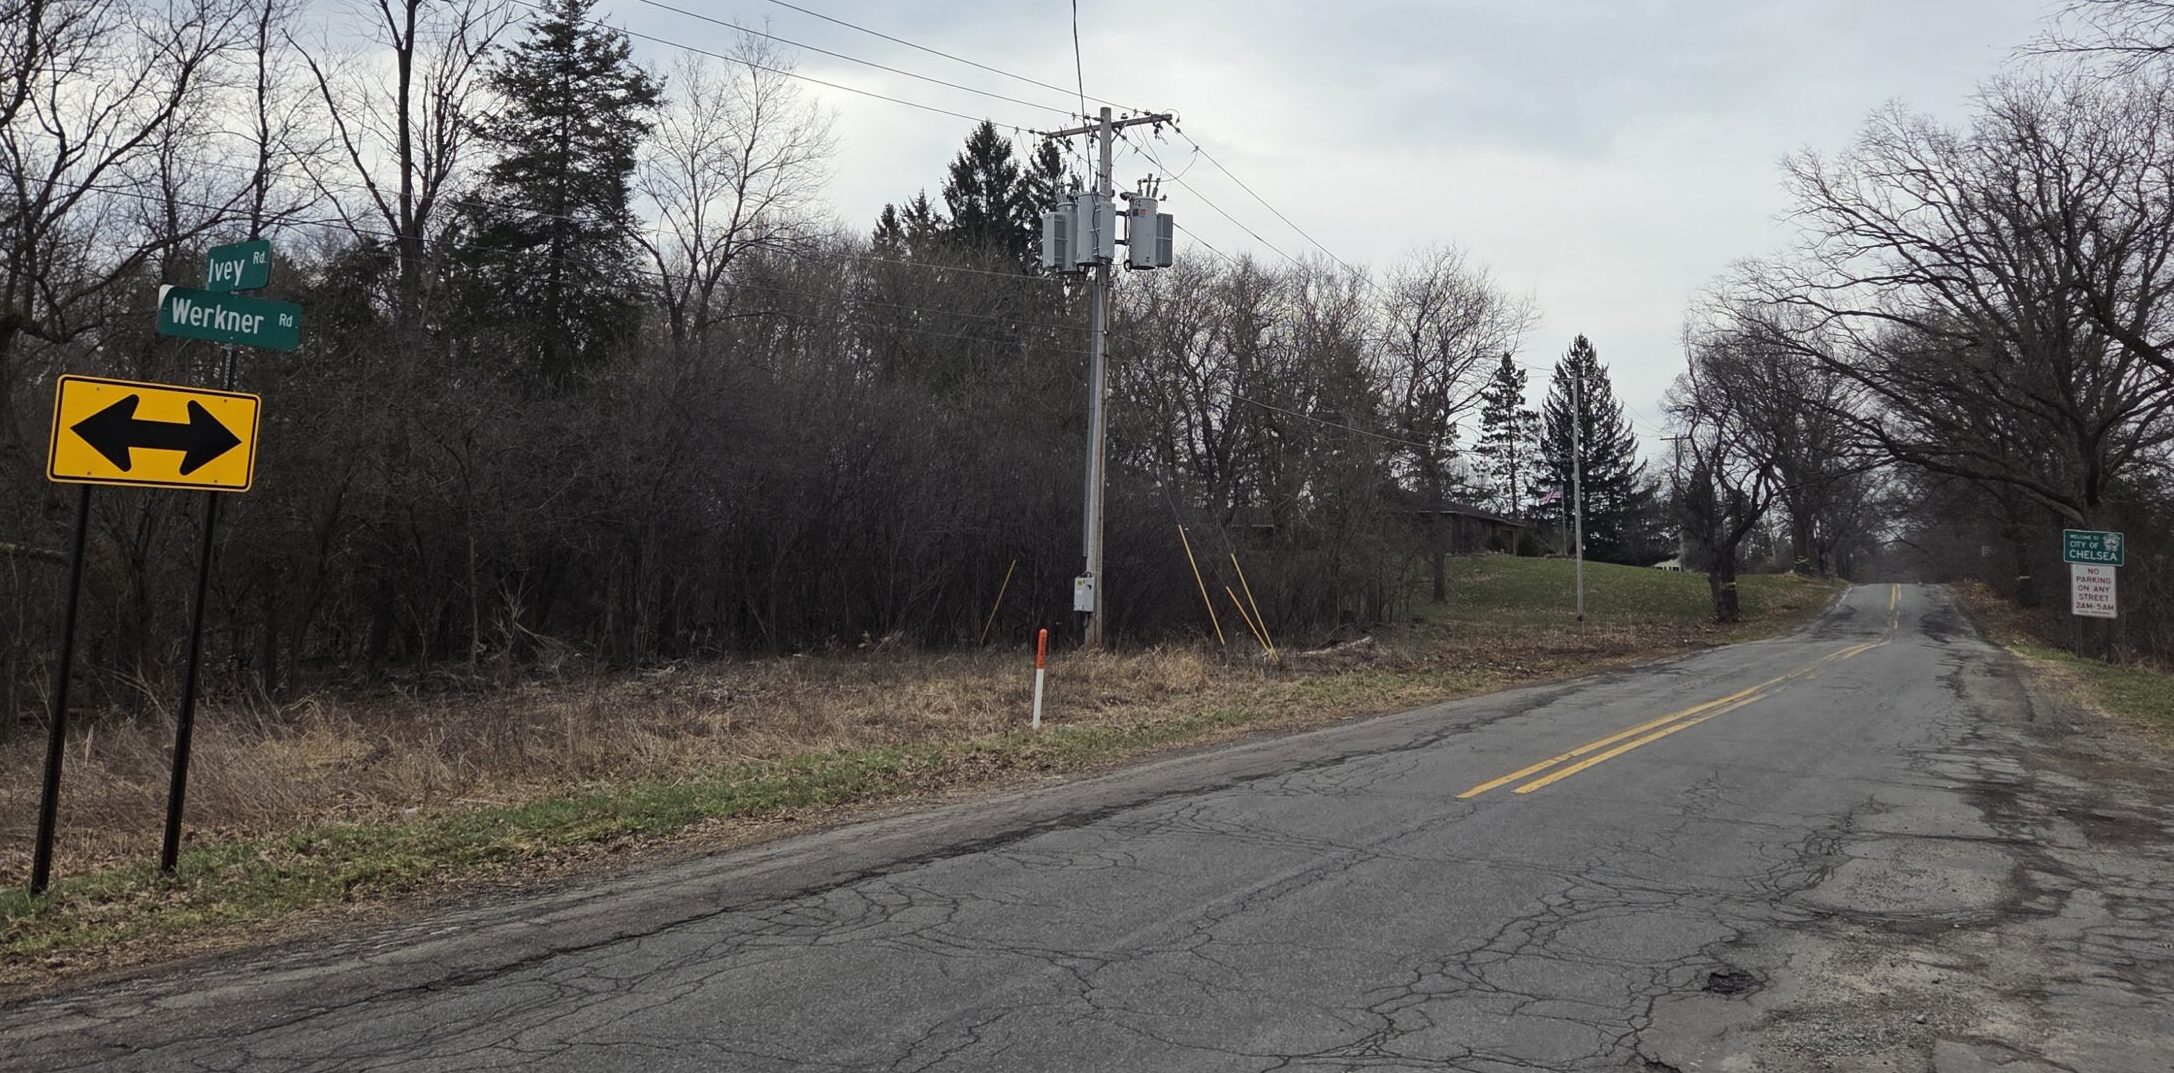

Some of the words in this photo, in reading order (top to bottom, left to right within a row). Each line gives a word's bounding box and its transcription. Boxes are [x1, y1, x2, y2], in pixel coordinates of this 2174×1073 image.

[208, 258, 245, 287] Ivey
[172, 297, 264, 334] Werkner
[2069, 541, 2086, 549] CITY
[2069, 550, 2117, 561] CHELSEA
[2076, 576, 2111, 584] PARKING
